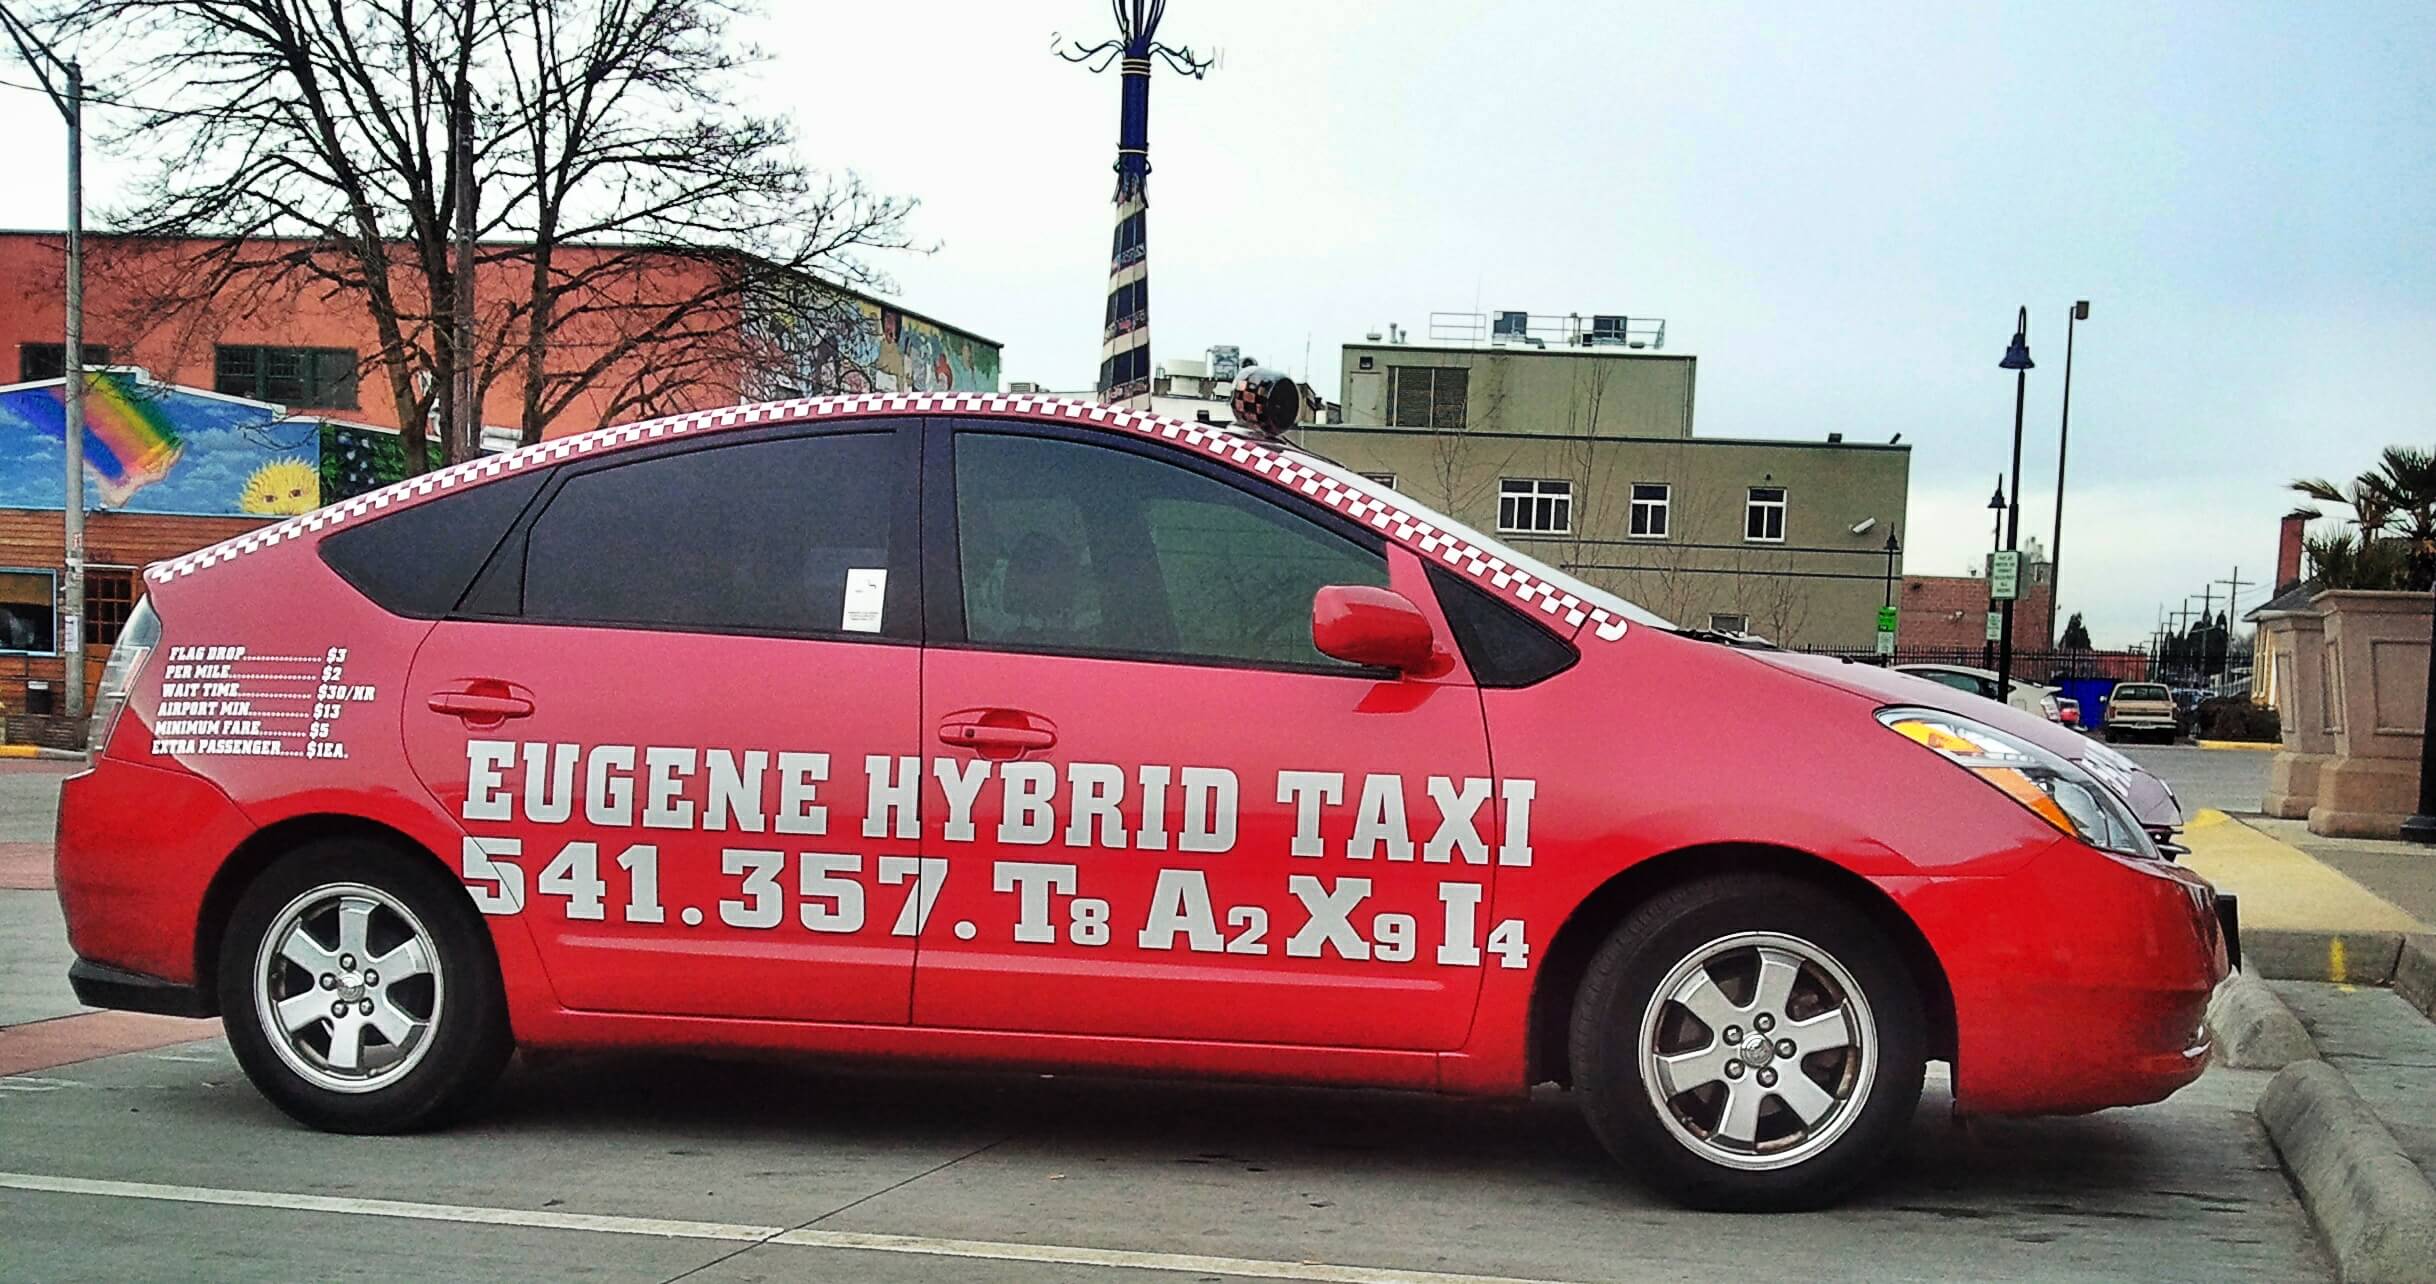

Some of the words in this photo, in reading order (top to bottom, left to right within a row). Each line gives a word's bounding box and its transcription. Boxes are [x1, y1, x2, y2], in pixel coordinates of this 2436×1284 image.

[169, 646, 205, 661] FLAG
[326, 646, 348, 664] $3
[165, 665, 192, 679] PER
[321, 665, 343, 682] $2
[162, 683, 200, 697] WAIT
[317, 683, 376, 701] $30/HR
[157, 701, 218, 716] AIRPORT
[313, 702, 341, 720] $13
[155, 721, 221, 735] MINIMUM
[309, 721, 330, 739] $5
[152, 739, 195, 755] EXTRA
[462, 739, 830, 843] EUGENE
[861, 754, 1238, 854] HYBRID
[1276, 769, 1536, 868] TAXI
